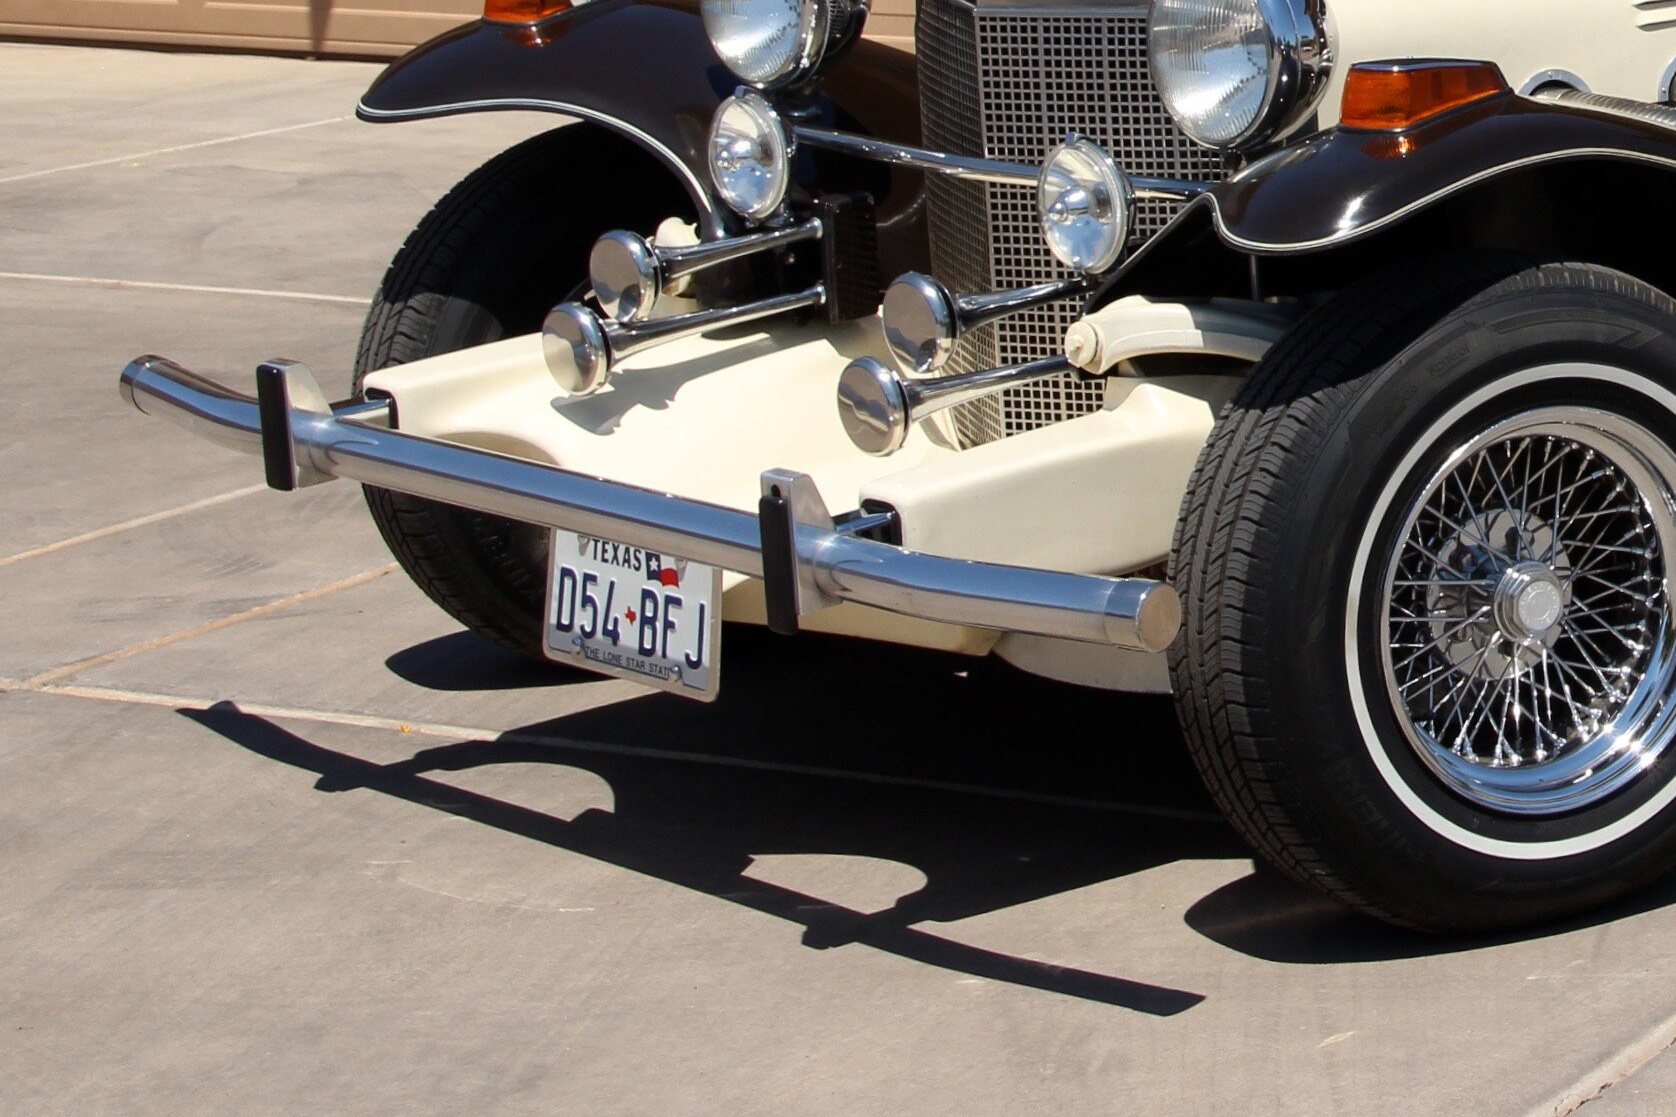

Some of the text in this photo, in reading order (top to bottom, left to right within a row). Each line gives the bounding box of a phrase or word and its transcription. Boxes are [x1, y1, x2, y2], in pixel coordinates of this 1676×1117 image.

[592, 538, 642, 572] TEXAS
[555, 565, 706, 670] D54 BFJ
[586, 646, 600, 659] THE
[603, 652, 623, 666] LONE
[626, 658, 646, 671] STAR
